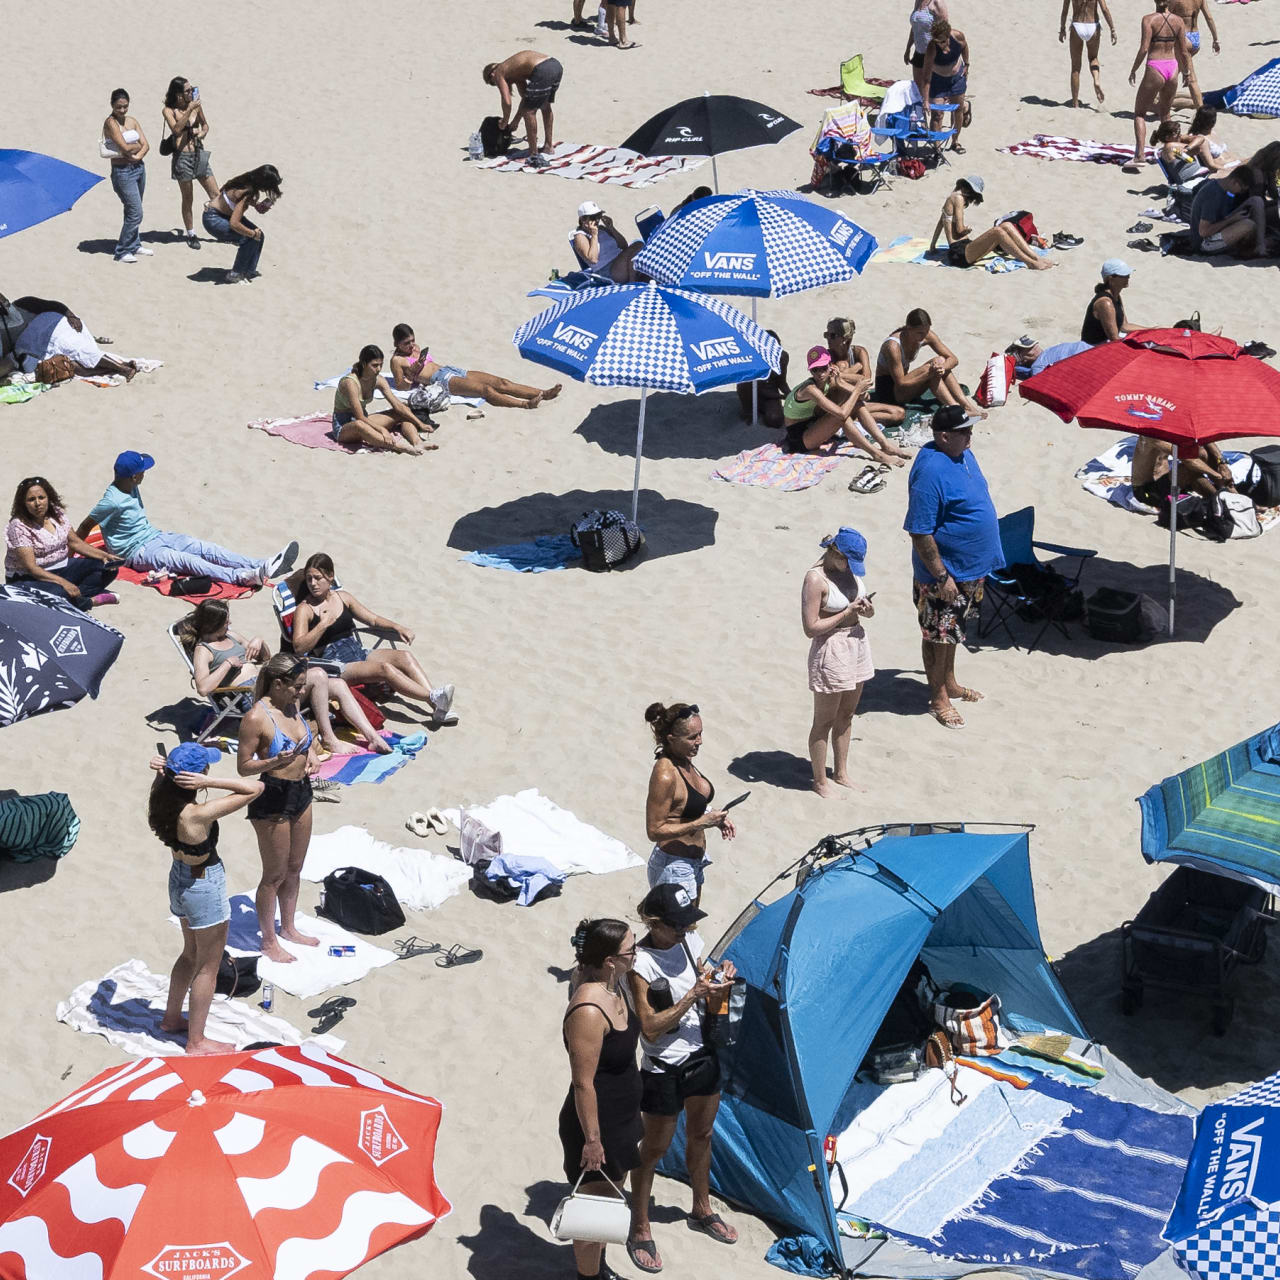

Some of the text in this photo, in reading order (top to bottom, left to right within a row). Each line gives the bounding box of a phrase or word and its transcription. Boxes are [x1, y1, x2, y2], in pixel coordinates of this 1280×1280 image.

[830, 219, 853, 247] VANS
[704, 251, 757, 271] VANS
[691, 271, 761, 280] "OFF THE WALL"
[553, 322, 599, 350] VANS
[535, 337, 588, 361] "OFF THE WALL"
[689, 336, 741, 360] VANS
[693, 354, 753, 373] "OFF THE WALL"
[1115, 393, 1143, 402] TOMMY
[371, 1113, 385, 1159] SURFBOARDS
[1220, 1116, 1264, 1200] VANS
[173, 1249, 221, 1258] JACK'S
[158, 1257, 235, 1273] SURFBOARDS
